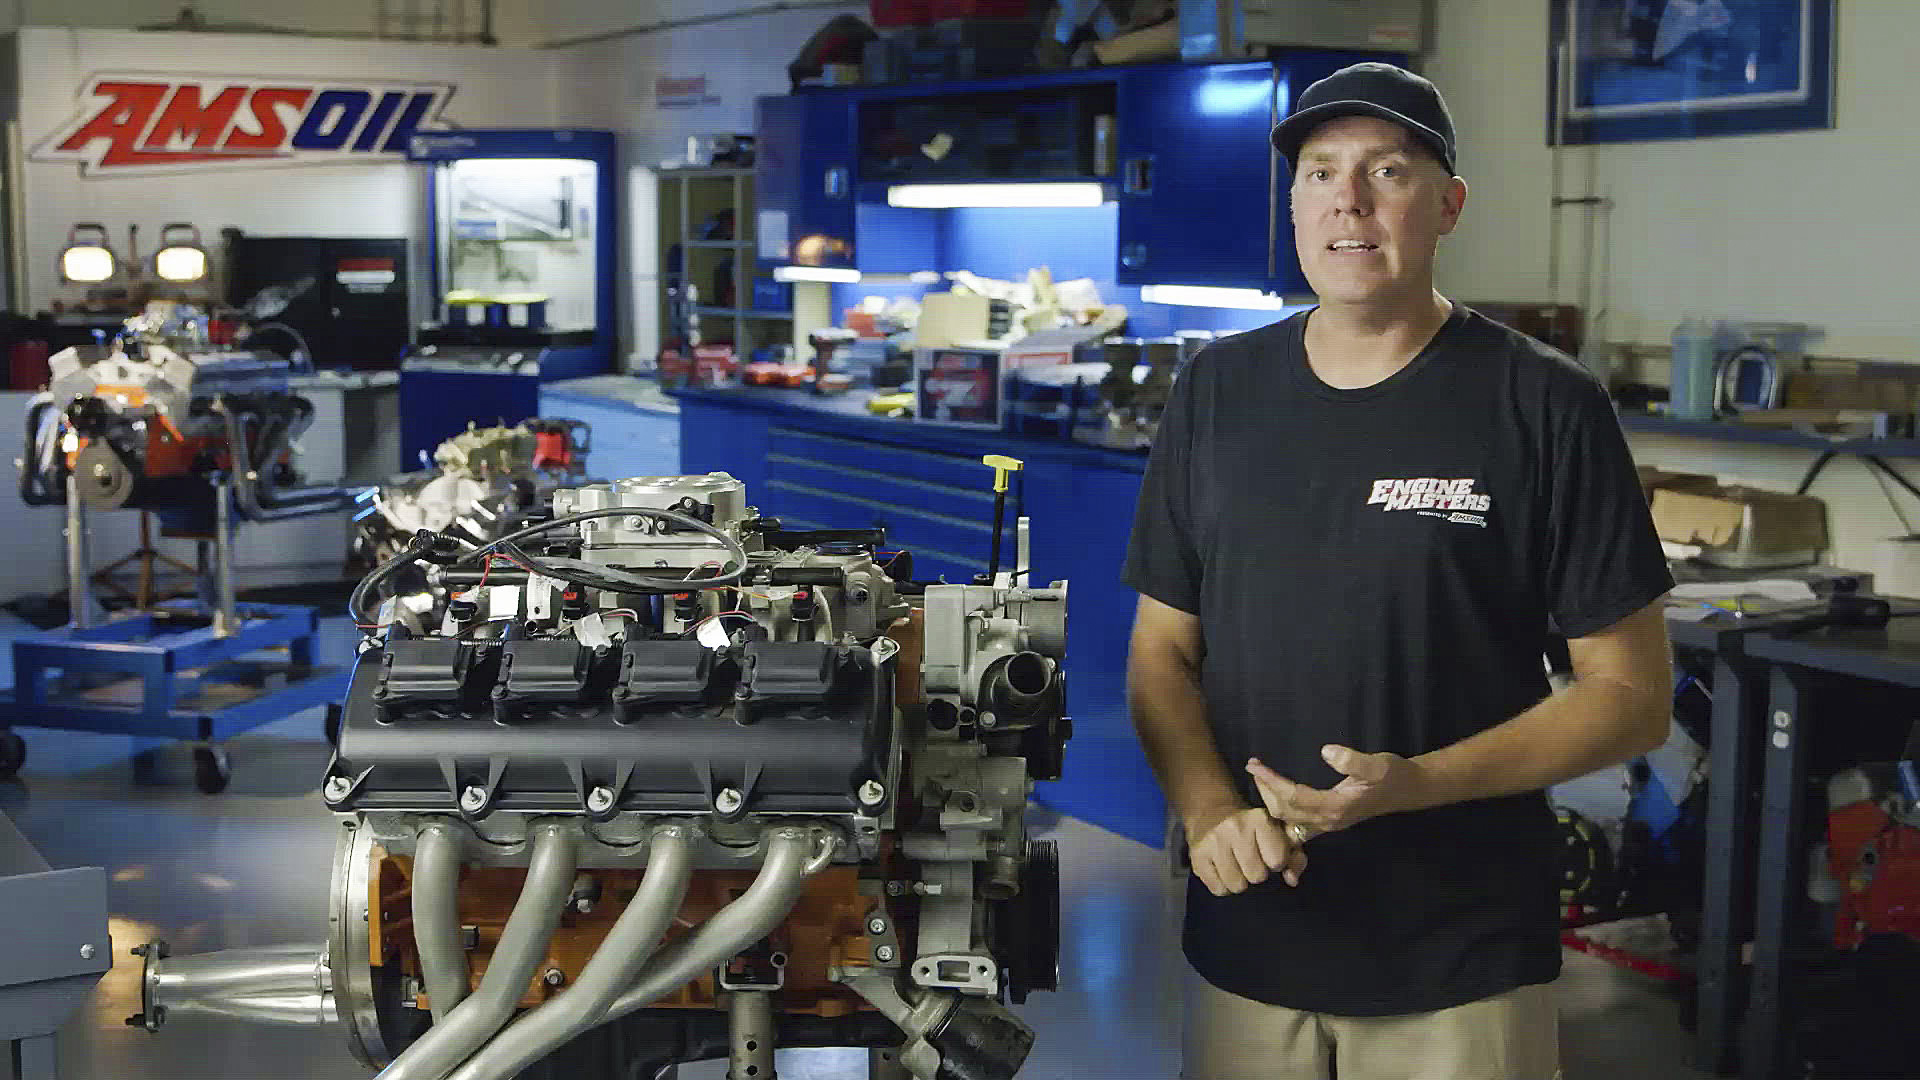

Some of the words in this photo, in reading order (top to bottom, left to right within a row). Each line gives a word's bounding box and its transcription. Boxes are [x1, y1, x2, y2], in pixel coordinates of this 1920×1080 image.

[56, 81, 436, 167] AMSOIL
[1367, 478, 1475, 505] ENGINE
[1383, 494, 1491, 512] MASTERS
[1450, 512, 1485, 524] AMSOIL
